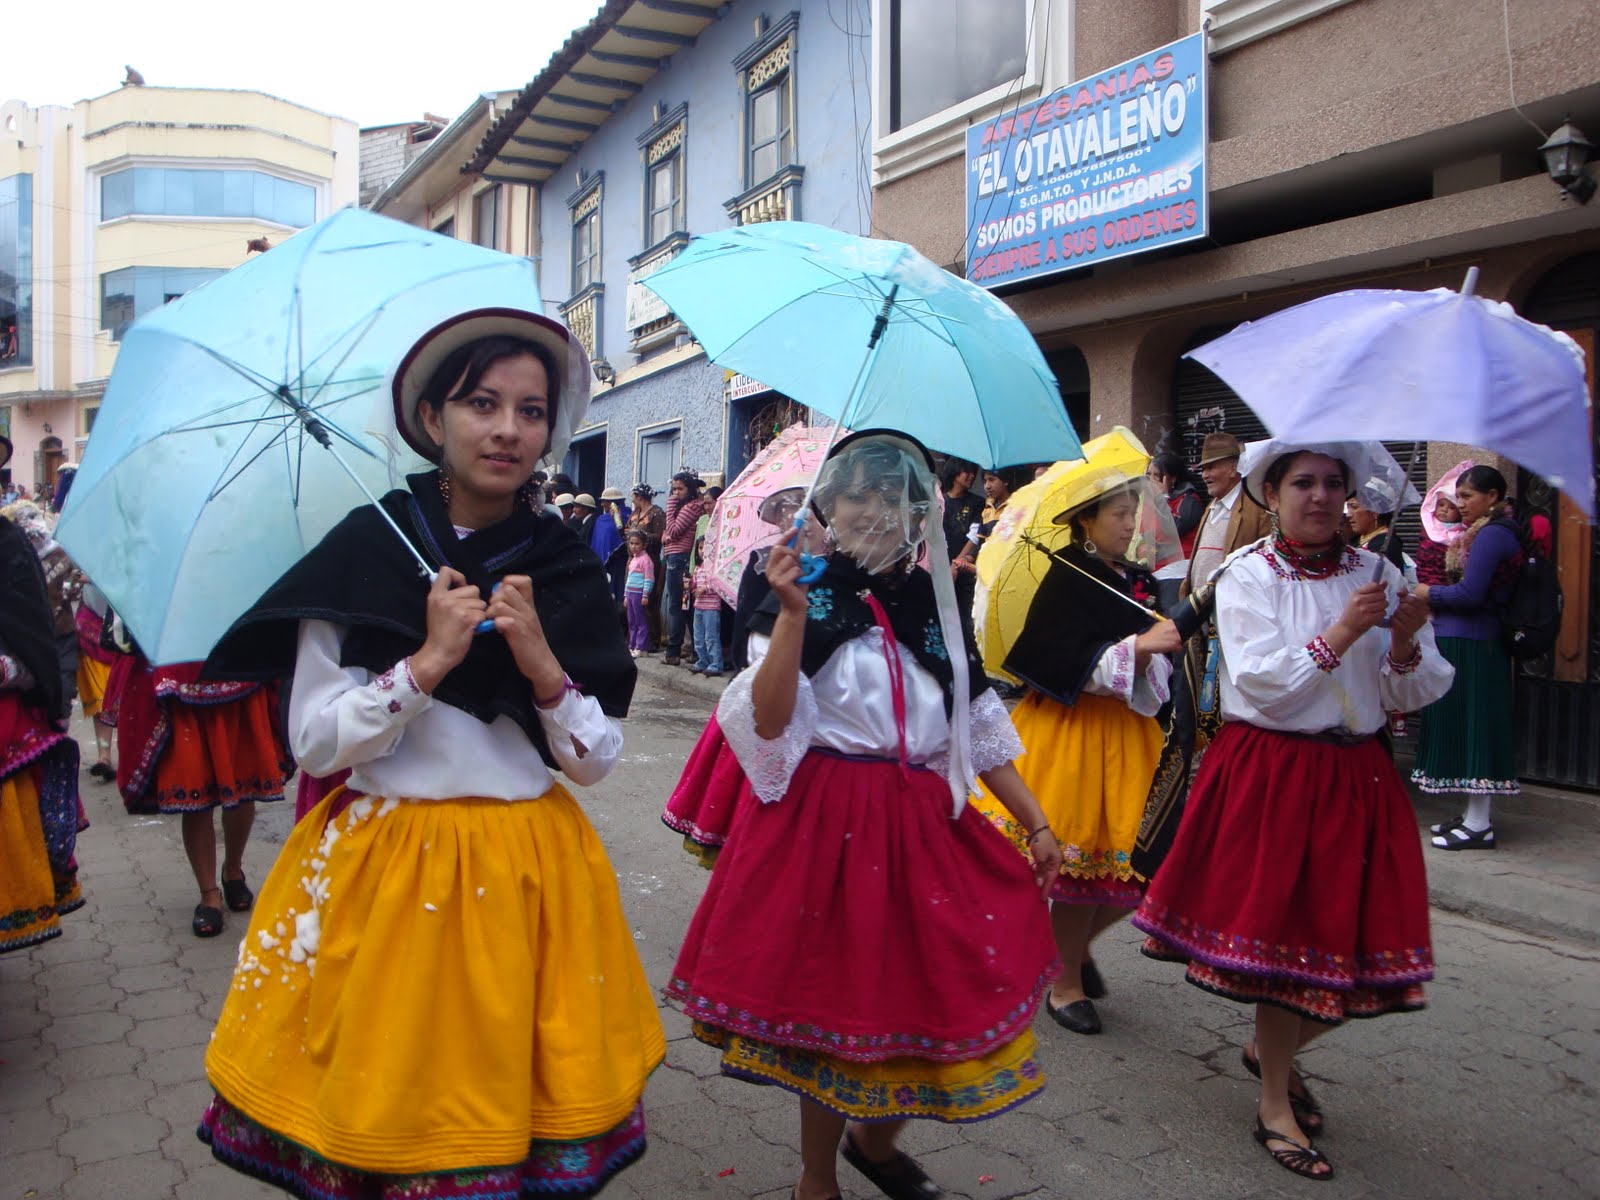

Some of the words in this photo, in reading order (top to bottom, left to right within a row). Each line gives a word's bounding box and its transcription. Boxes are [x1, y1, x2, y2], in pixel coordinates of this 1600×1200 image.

[982, 52, 1175, 147] ARTESANIAS
[976, 209, 1037, 249] SOMOS
[1041, 163, 1193, 231] PRODUCTORES
[1020, 183, 1075, 209] S.G.M.T.O.
[1081, 177, 1090, 190] Y
[1092, 163, 1142, 187] J.N.D.A.
[973, 240, 1041, 281] SIEMPRE
[1044, 236, 1057, 264] A
[1062, 226, 1097, 259] SUS
[1103, 198, 1197, 249] ORDENES
